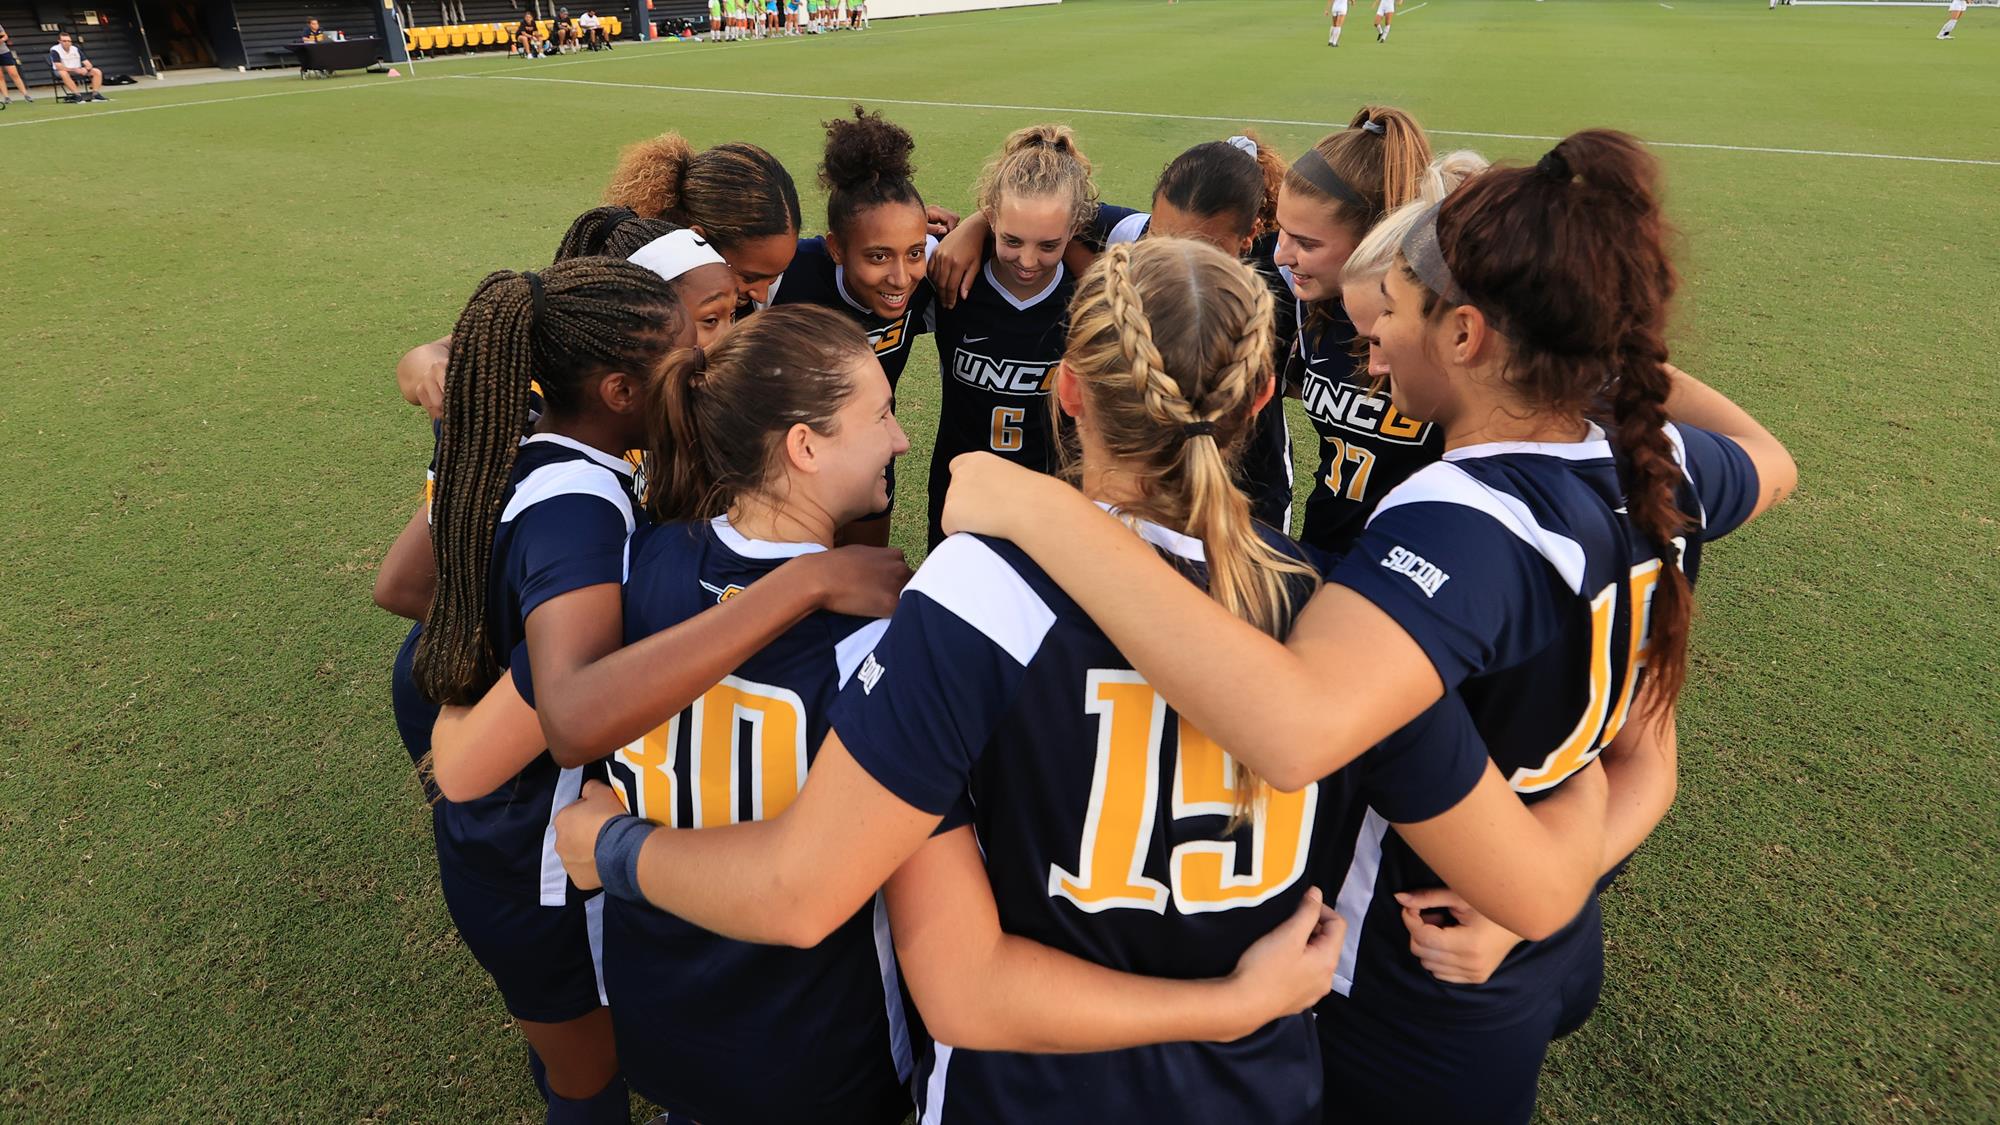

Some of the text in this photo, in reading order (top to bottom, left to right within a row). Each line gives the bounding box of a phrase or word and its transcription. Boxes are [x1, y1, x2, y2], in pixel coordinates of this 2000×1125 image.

[954, 348, 1058, 394] UNC
[990, 406, 1025, 451] 6
[1302, 369, 1432, 445] UNCG
[1323, 435, 1376, 502] 17
[1380, 545, 1450, 599] SOCON
[1048, 668, 1319, 915] 15
